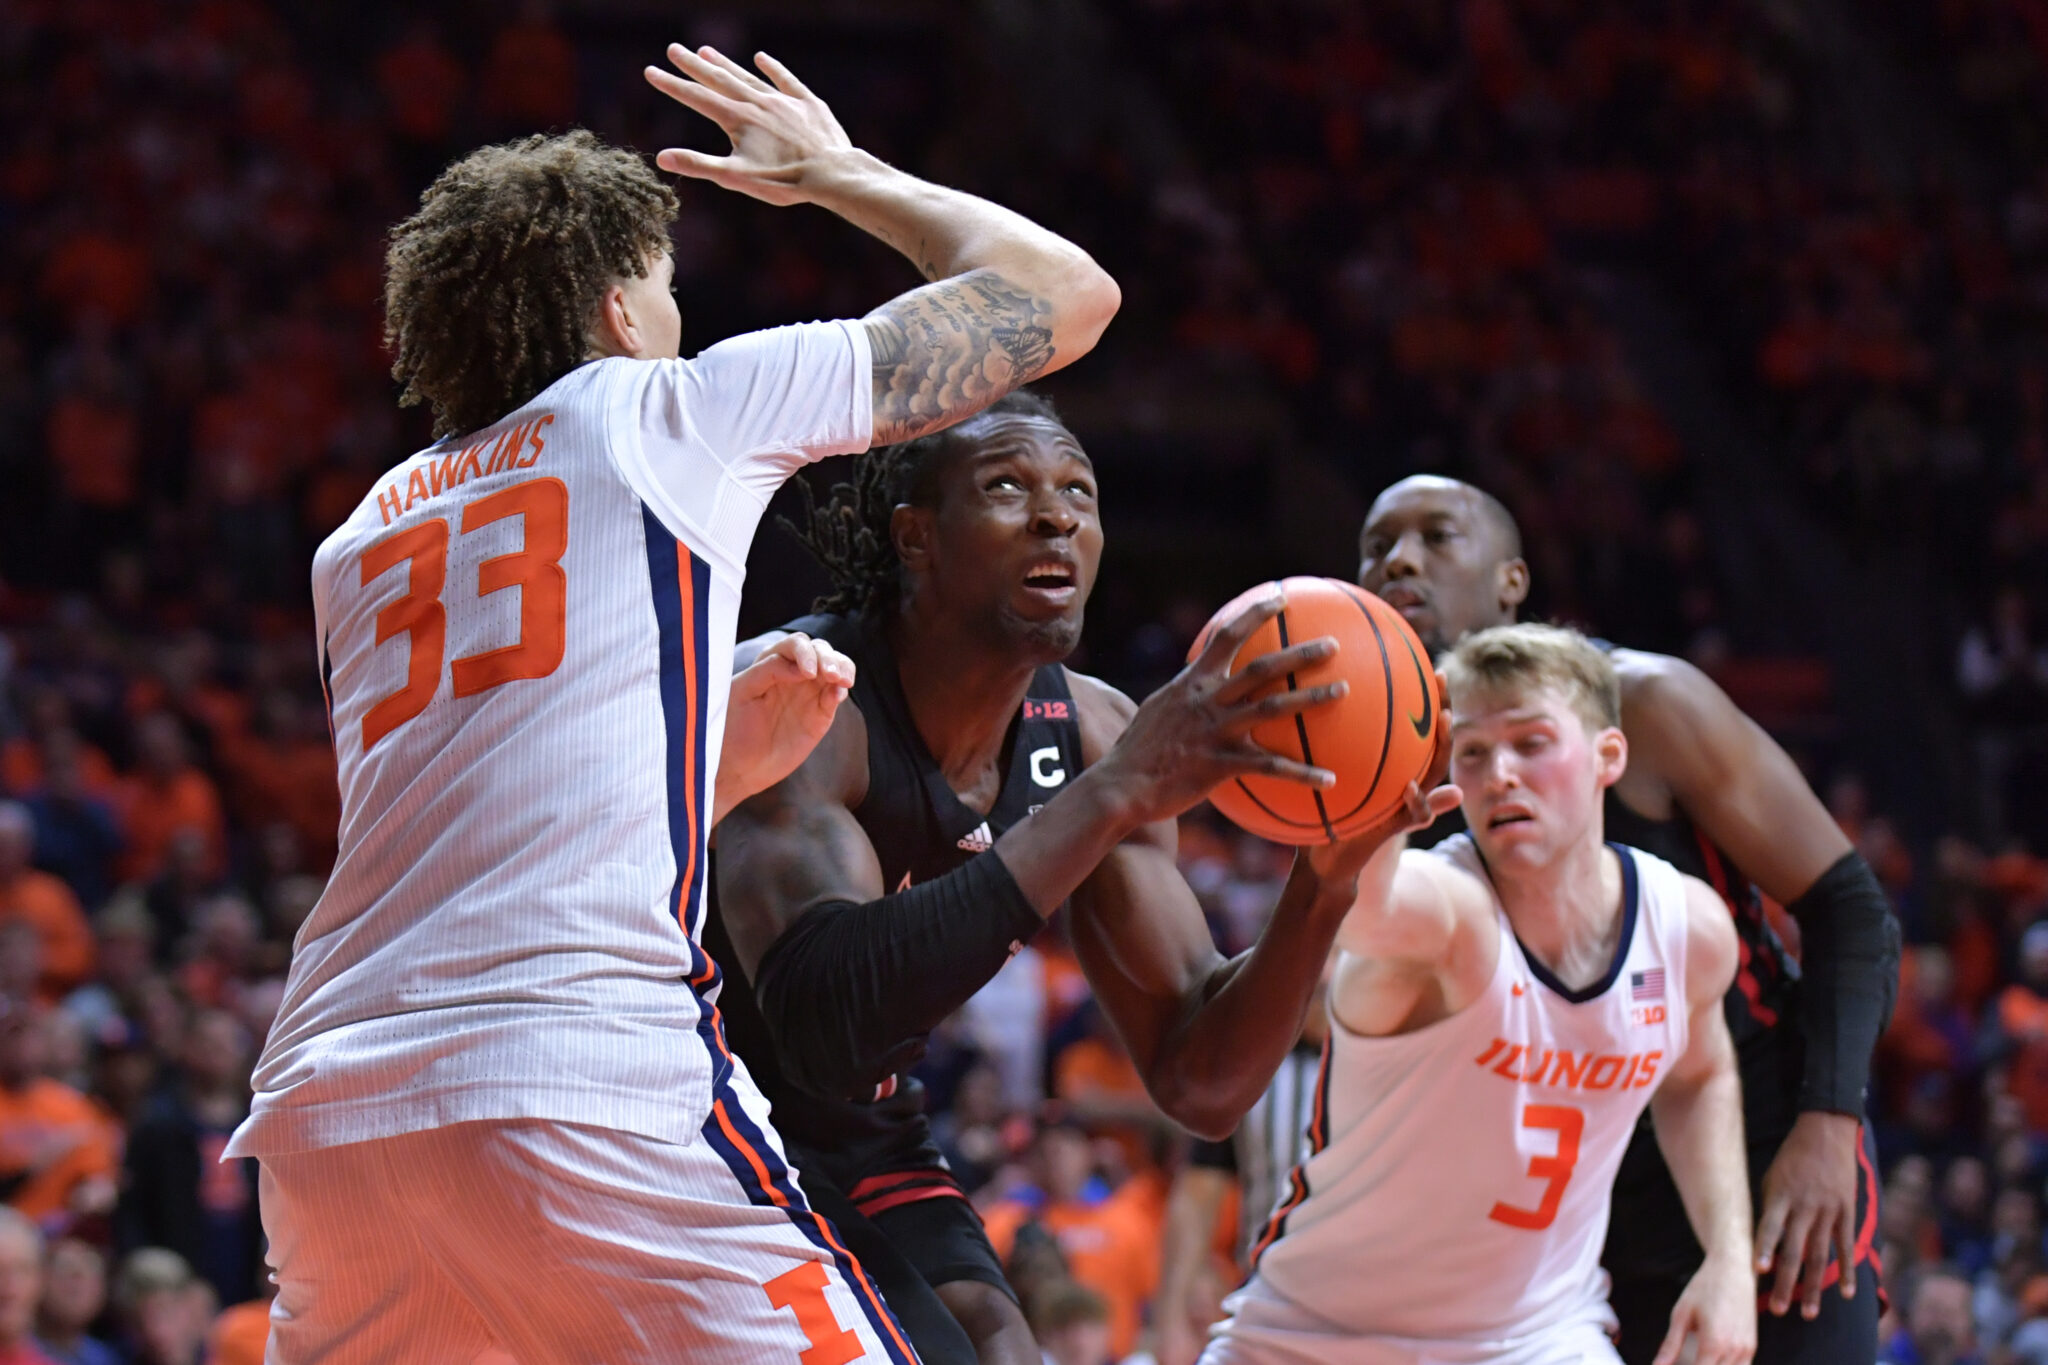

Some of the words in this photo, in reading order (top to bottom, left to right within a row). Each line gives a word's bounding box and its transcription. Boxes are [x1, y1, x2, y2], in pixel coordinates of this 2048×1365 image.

[377, 414, 555, 526] HAWKINS
[360, 477, 569, 752] 33
[1030, 746, 1066, 788] C
[1489, 1105, 1584, 1230] 3
